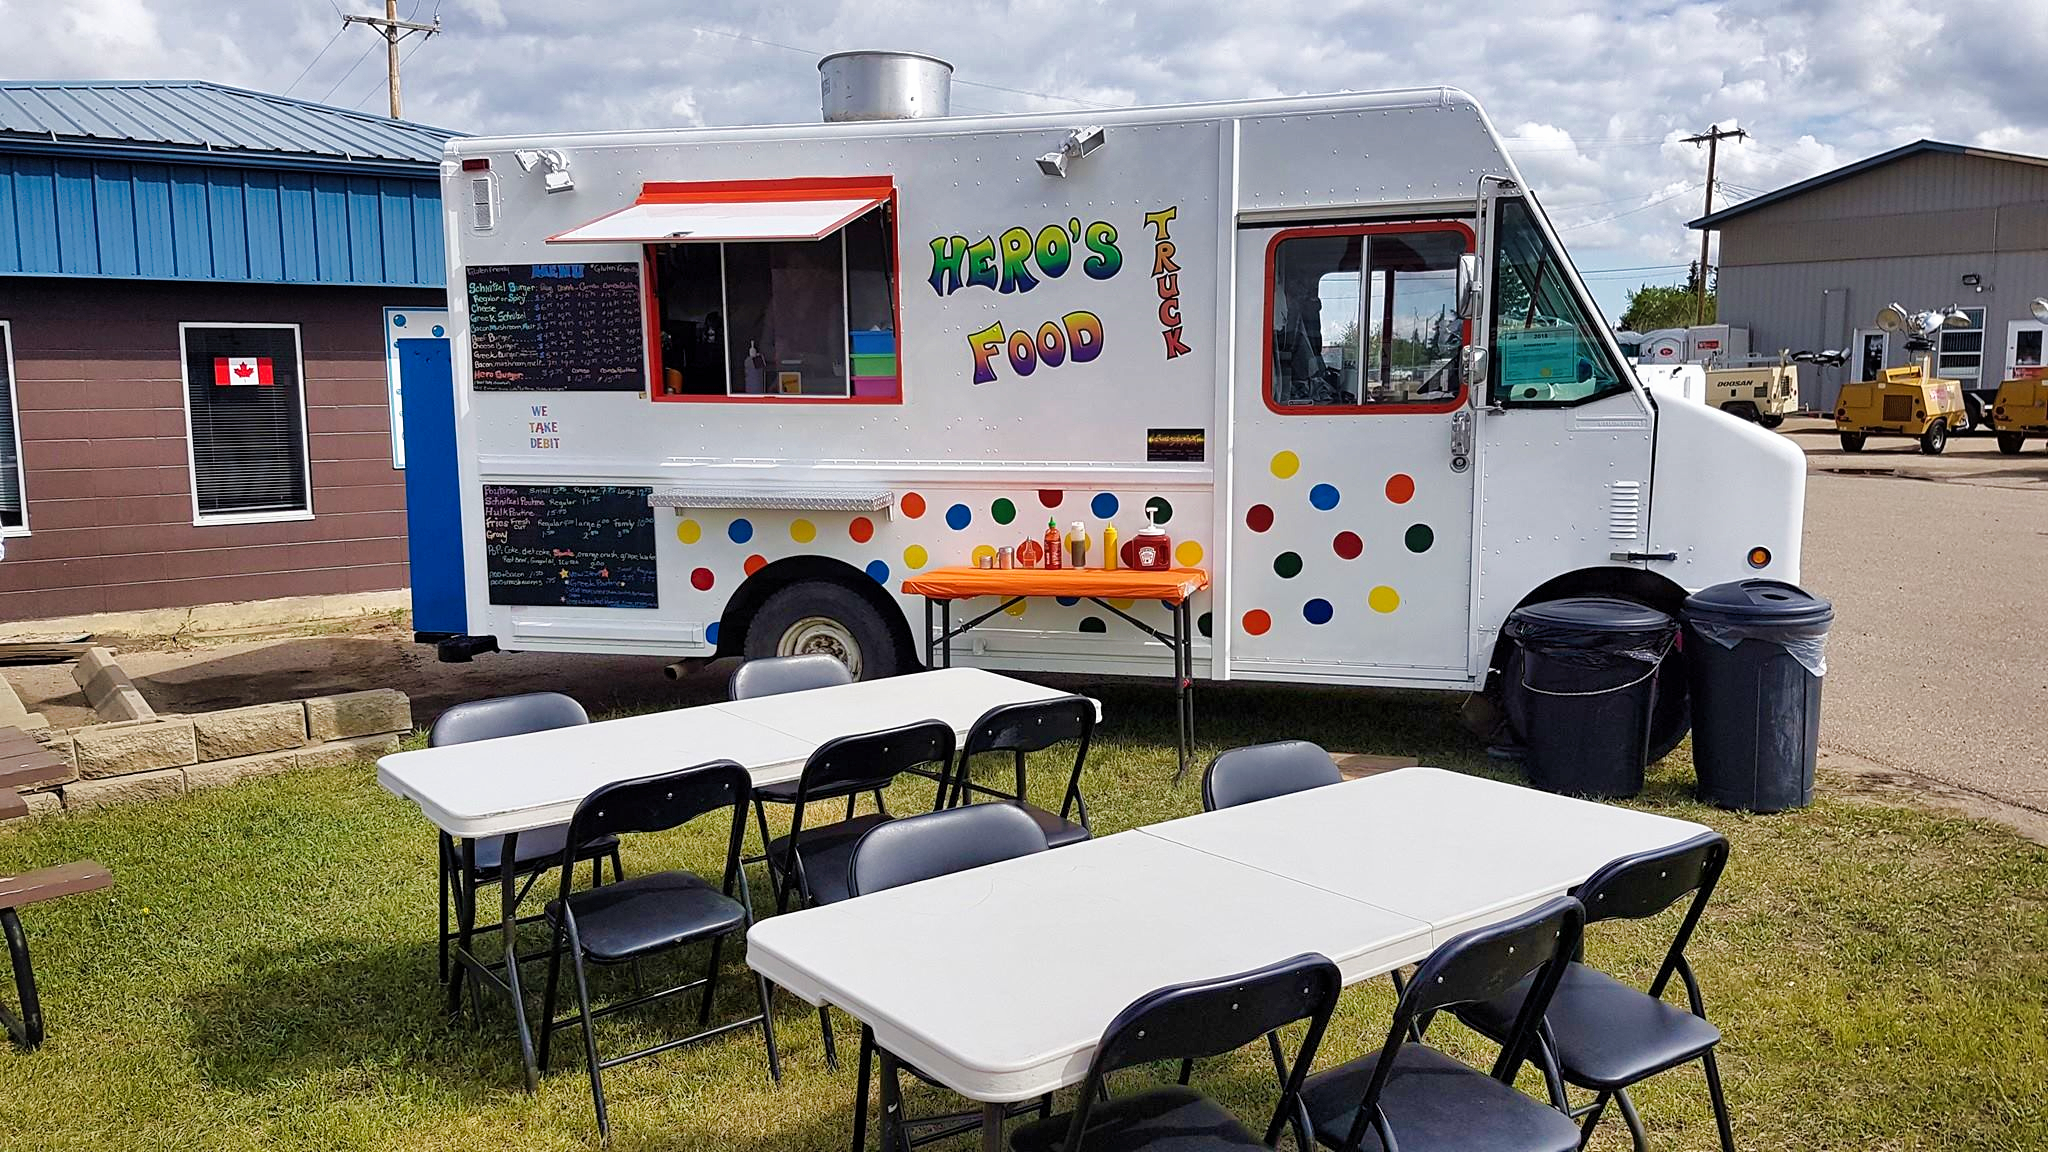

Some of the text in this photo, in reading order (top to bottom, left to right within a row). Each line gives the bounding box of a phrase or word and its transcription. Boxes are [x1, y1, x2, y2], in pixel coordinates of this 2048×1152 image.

[928, 217, 1123, 297] HERO'S
[1143, 206, 1192, 360] TRUCK
[968, 310, 1104, 385] FOOD
[1717, 380, 1753, 388] DOOSAN
[531, 405, 548, 416] WE
[529, 422, 558, 434] TAKE
[530, 438, 560, 448] DEBIT
[485, 507, 508, 516] Hulk
[486, 517, 510, 528] Fries
[486, 530, 508, 544] Gravy
